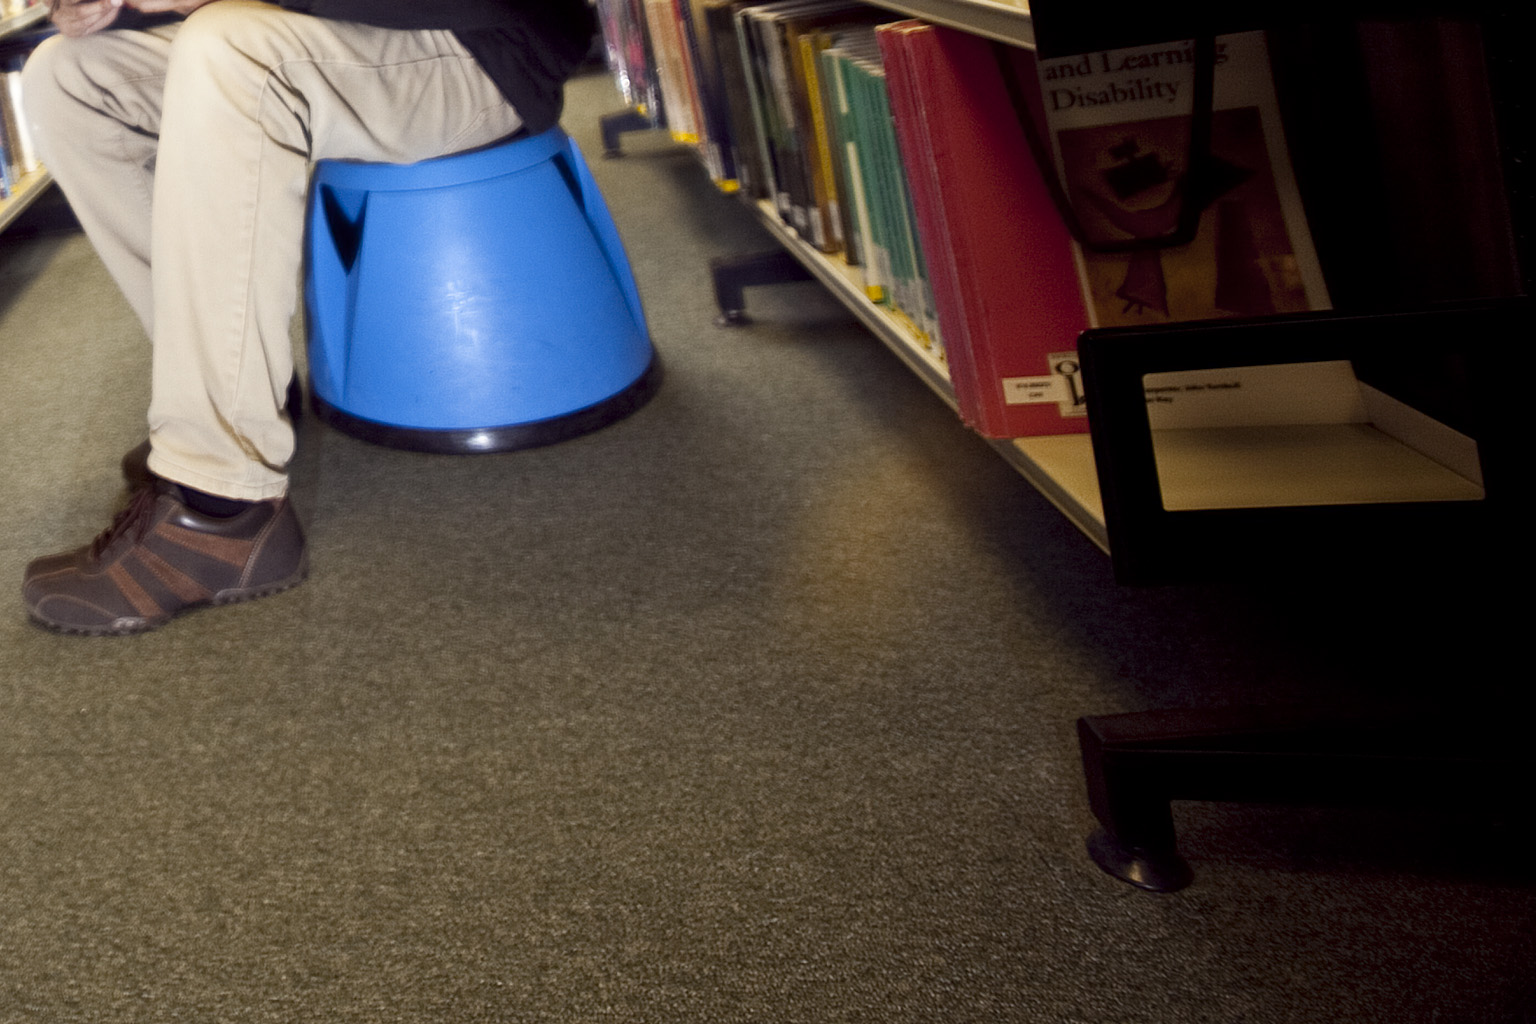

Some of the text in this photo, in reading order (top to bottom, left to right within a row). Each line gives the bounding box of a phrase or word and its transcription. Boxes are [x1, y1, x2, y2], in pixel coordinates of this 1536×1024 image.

[1045, 42, 1228, 80] and Learnig
[1050, 78, 1180, 110] Disability
